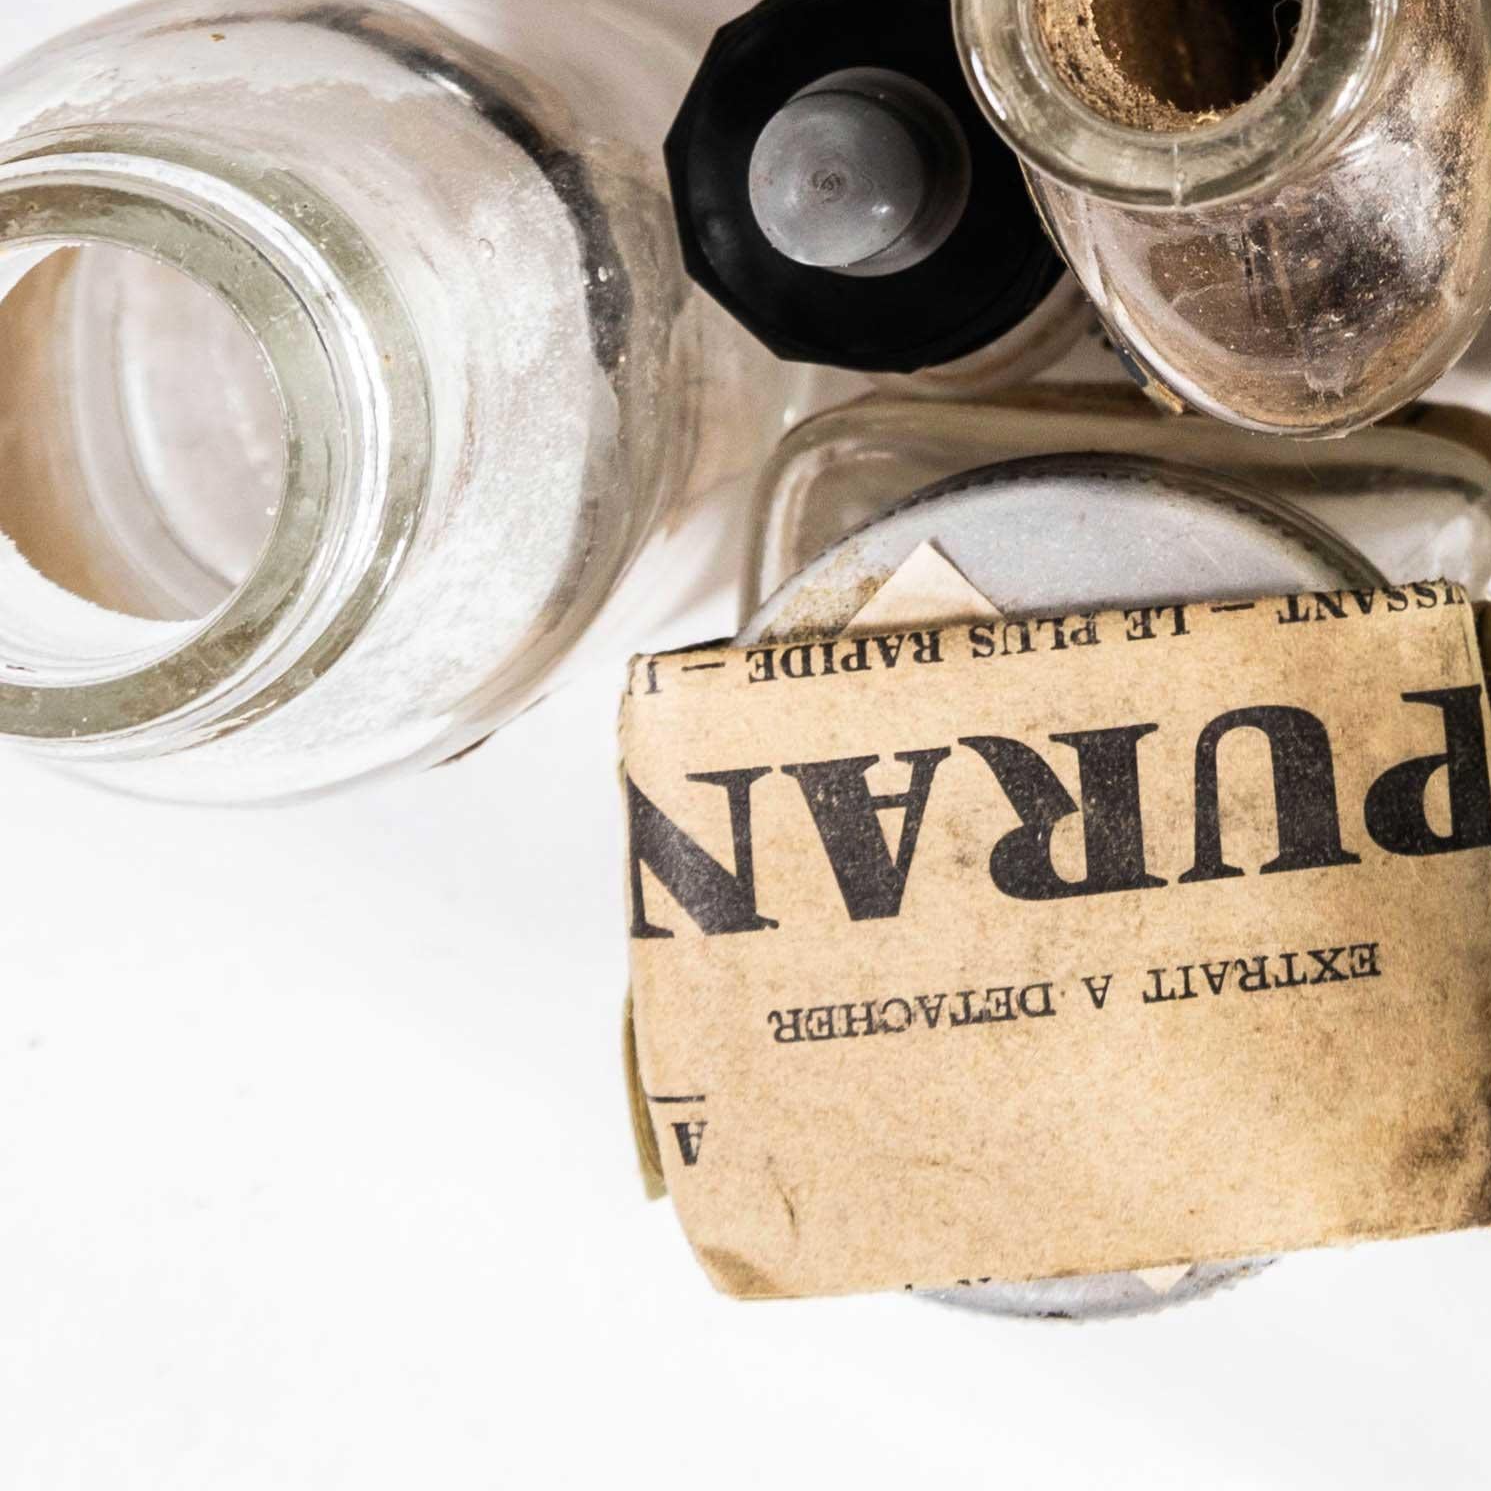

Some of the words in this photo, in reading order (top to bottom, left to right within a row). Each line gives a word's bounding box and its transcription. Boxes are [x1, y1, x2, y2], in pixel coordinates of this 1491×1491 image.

[972, 613, 1100, 661] PLUS
[1125, 607, 1193, 643] LE
[745, 630, 945, 686] RAPIDE
[1081, 974, 1113, 1010] A
[1140, 941, 1384, 1003] EXTRAIT
[766, 981, 1058, 1045] DETACHER
[669, 1118, 709, 1168] A
